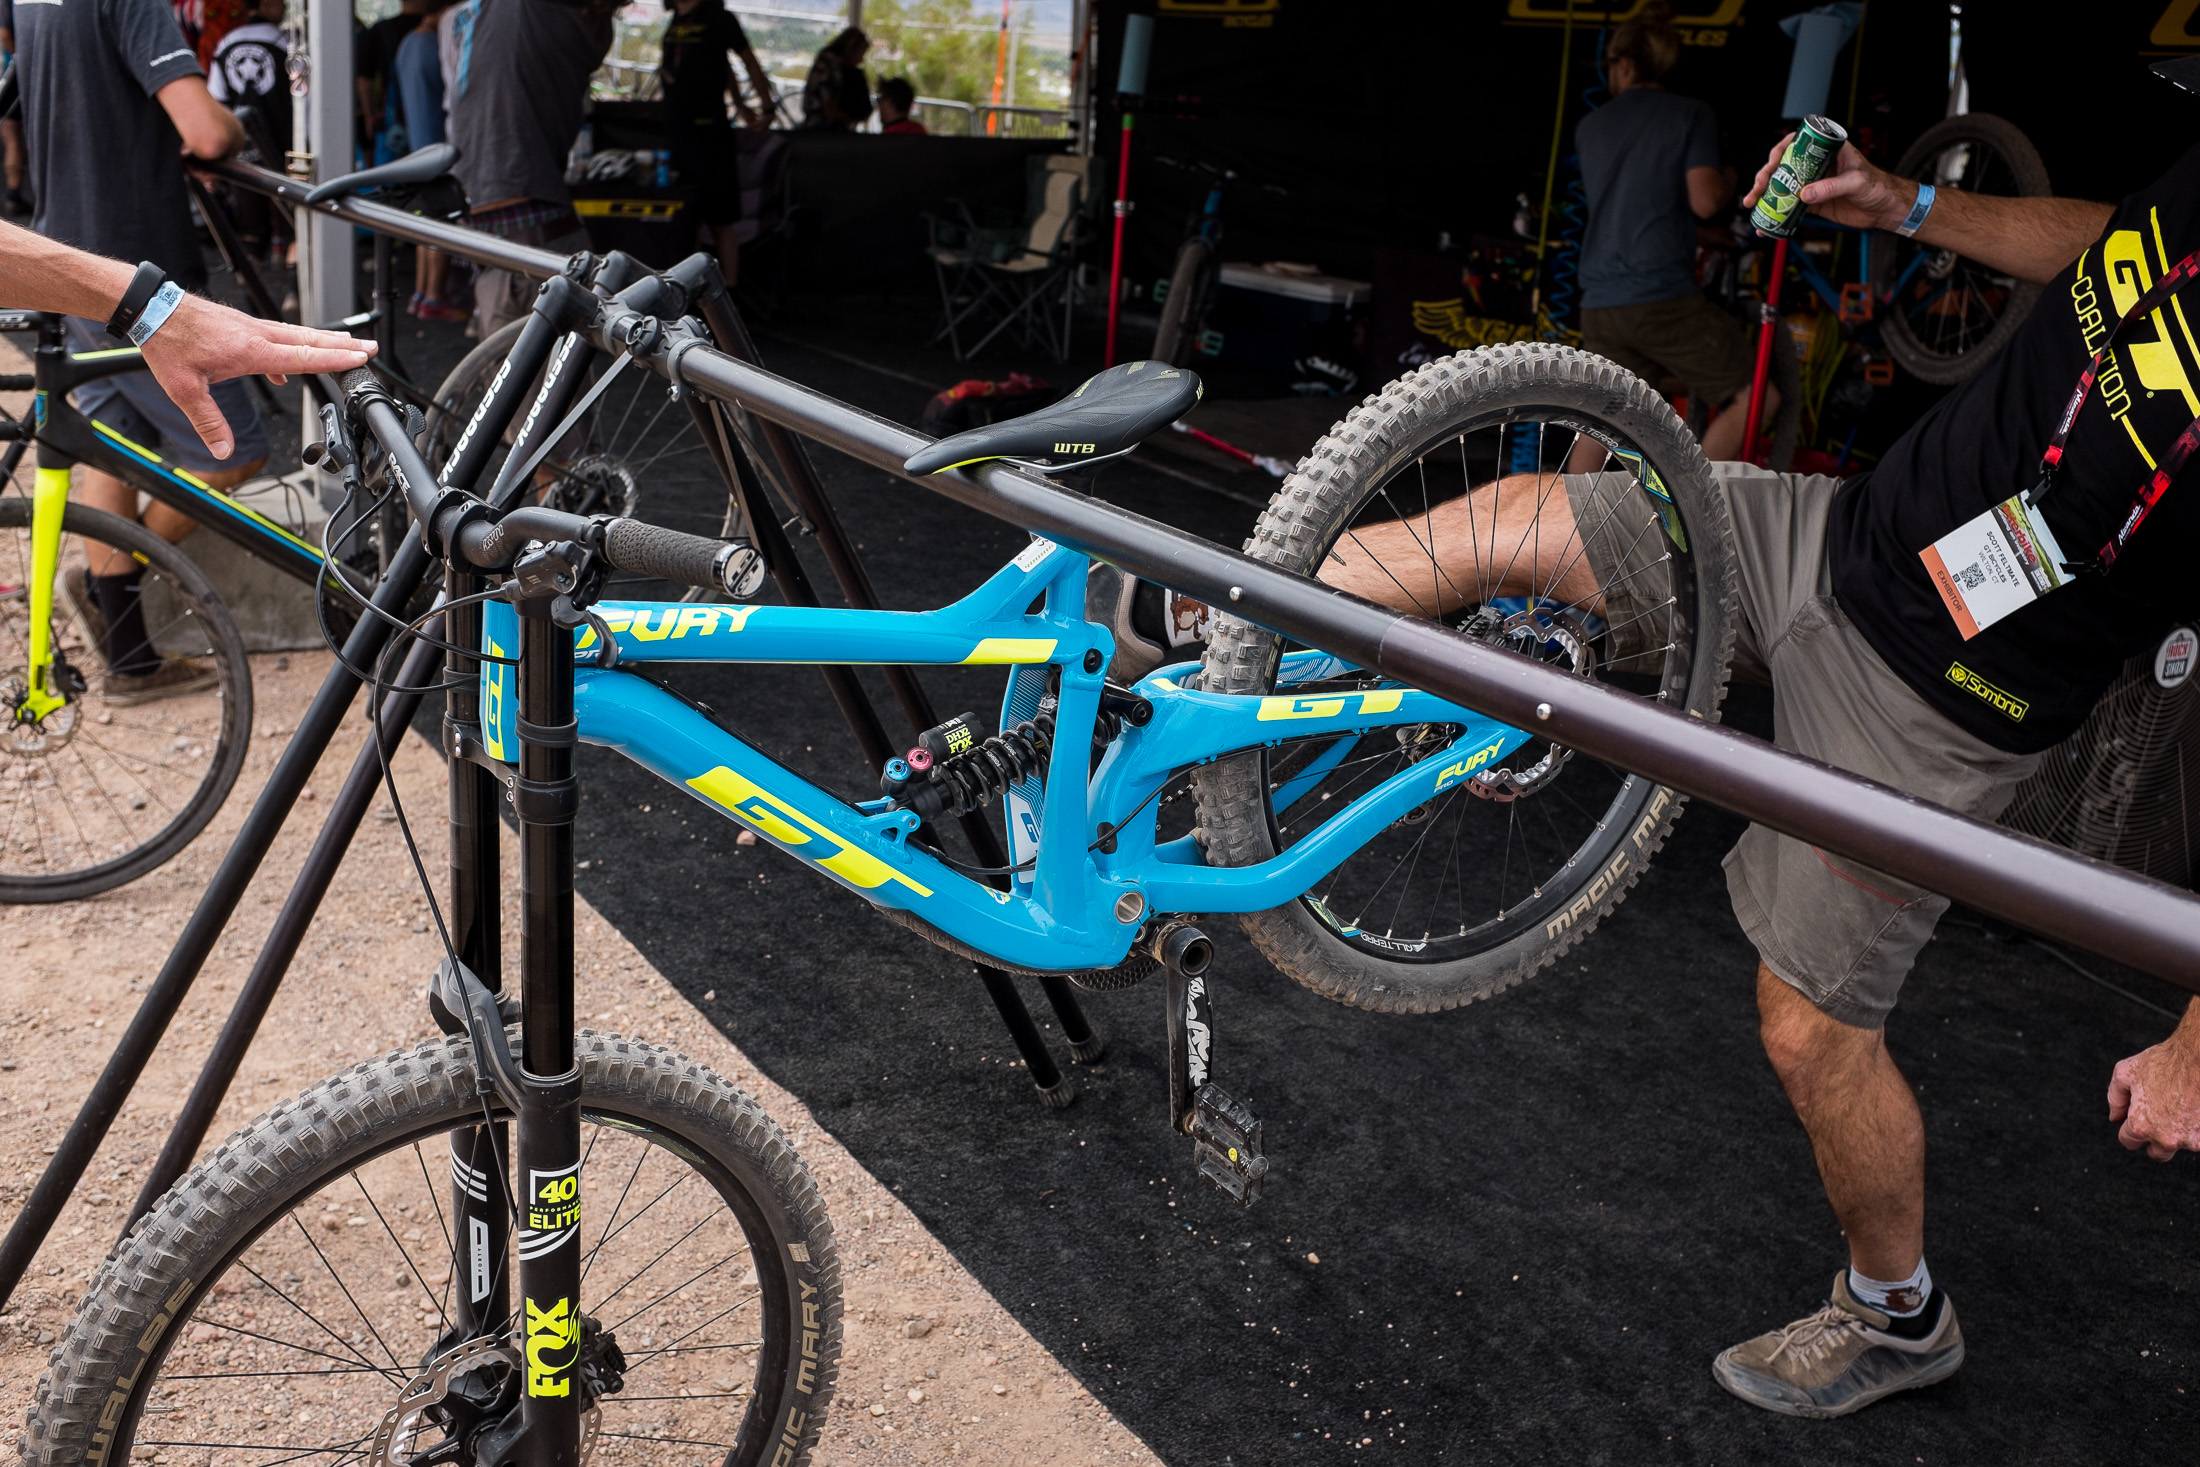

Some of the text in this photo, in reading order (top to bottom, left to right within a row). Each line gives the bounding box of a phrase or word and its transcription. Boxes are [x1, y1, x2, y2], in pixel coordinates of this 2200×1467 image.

[1771, 166, 1801, 194] errier
[1054, 442, 1096, 454] WTB
[1982, 544, 2008, 583] GT BICYCLES
[1985, 531, 2021, 587] SCOTT FELTMATE
[1935, 570, 1964, 612] EXHIBITOR
[1991, 575, 1999, 584] CT
[576, 606, 762, 650] FURY
[1257, 689, 1424, 722] GT
[1966, 677, 2023, 718] Sombrio
[946, 727, 970, 744] DHX2
[949, 735, 973, 754] FOX
[1435, 737, 1505, 788] FURY
[1433, 779, 1454, 794] PRO
[685, 766, 934, 898] GT
[1546, 786, 1675, 941] MAGIC MA
[538, 1176, 577, 1204] 40
[529, 1203, 580, 1230] ELITE
[526, 1297, 580, 1398] FOX
[796, 1278, 820, 1395] MARY
